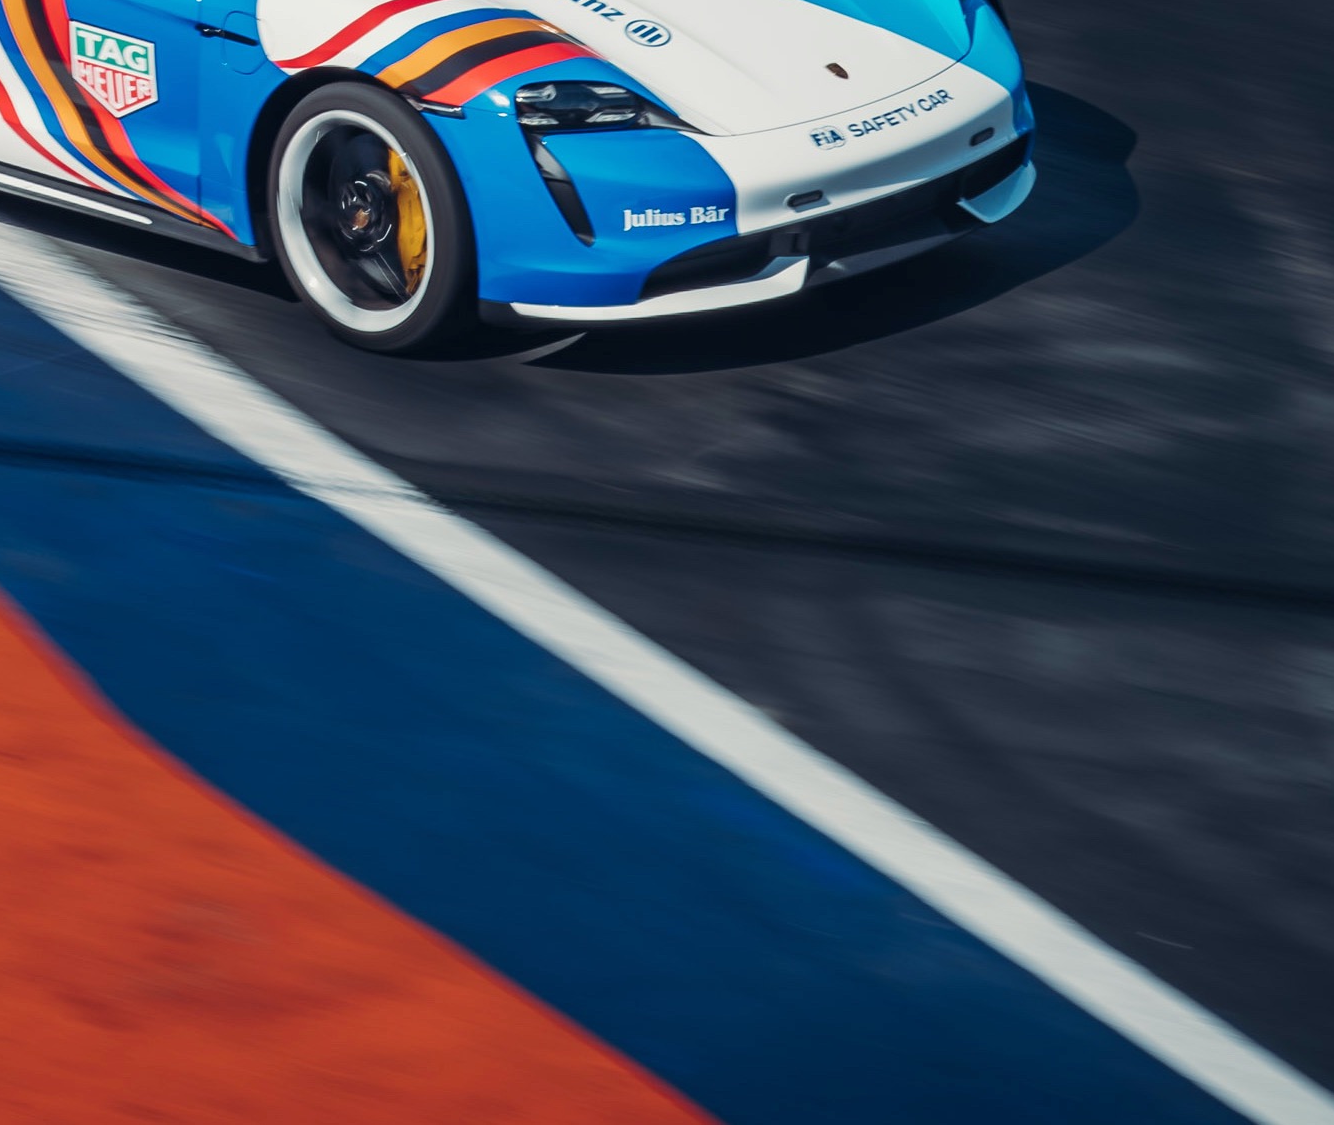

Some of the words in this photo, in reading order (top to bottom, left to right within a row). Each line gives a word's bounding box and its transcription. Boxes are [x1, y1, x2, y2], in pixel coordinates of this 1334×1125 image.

[76, 29, 148, 73] TAG
[76, 61, 152, 110] HEUER
[847, 103, 919, 138] SAFETY
[917, 88, 955, 112] CAR
[623, 208, 686, 232] Julius
[689, 205, 730, 225] Bär
